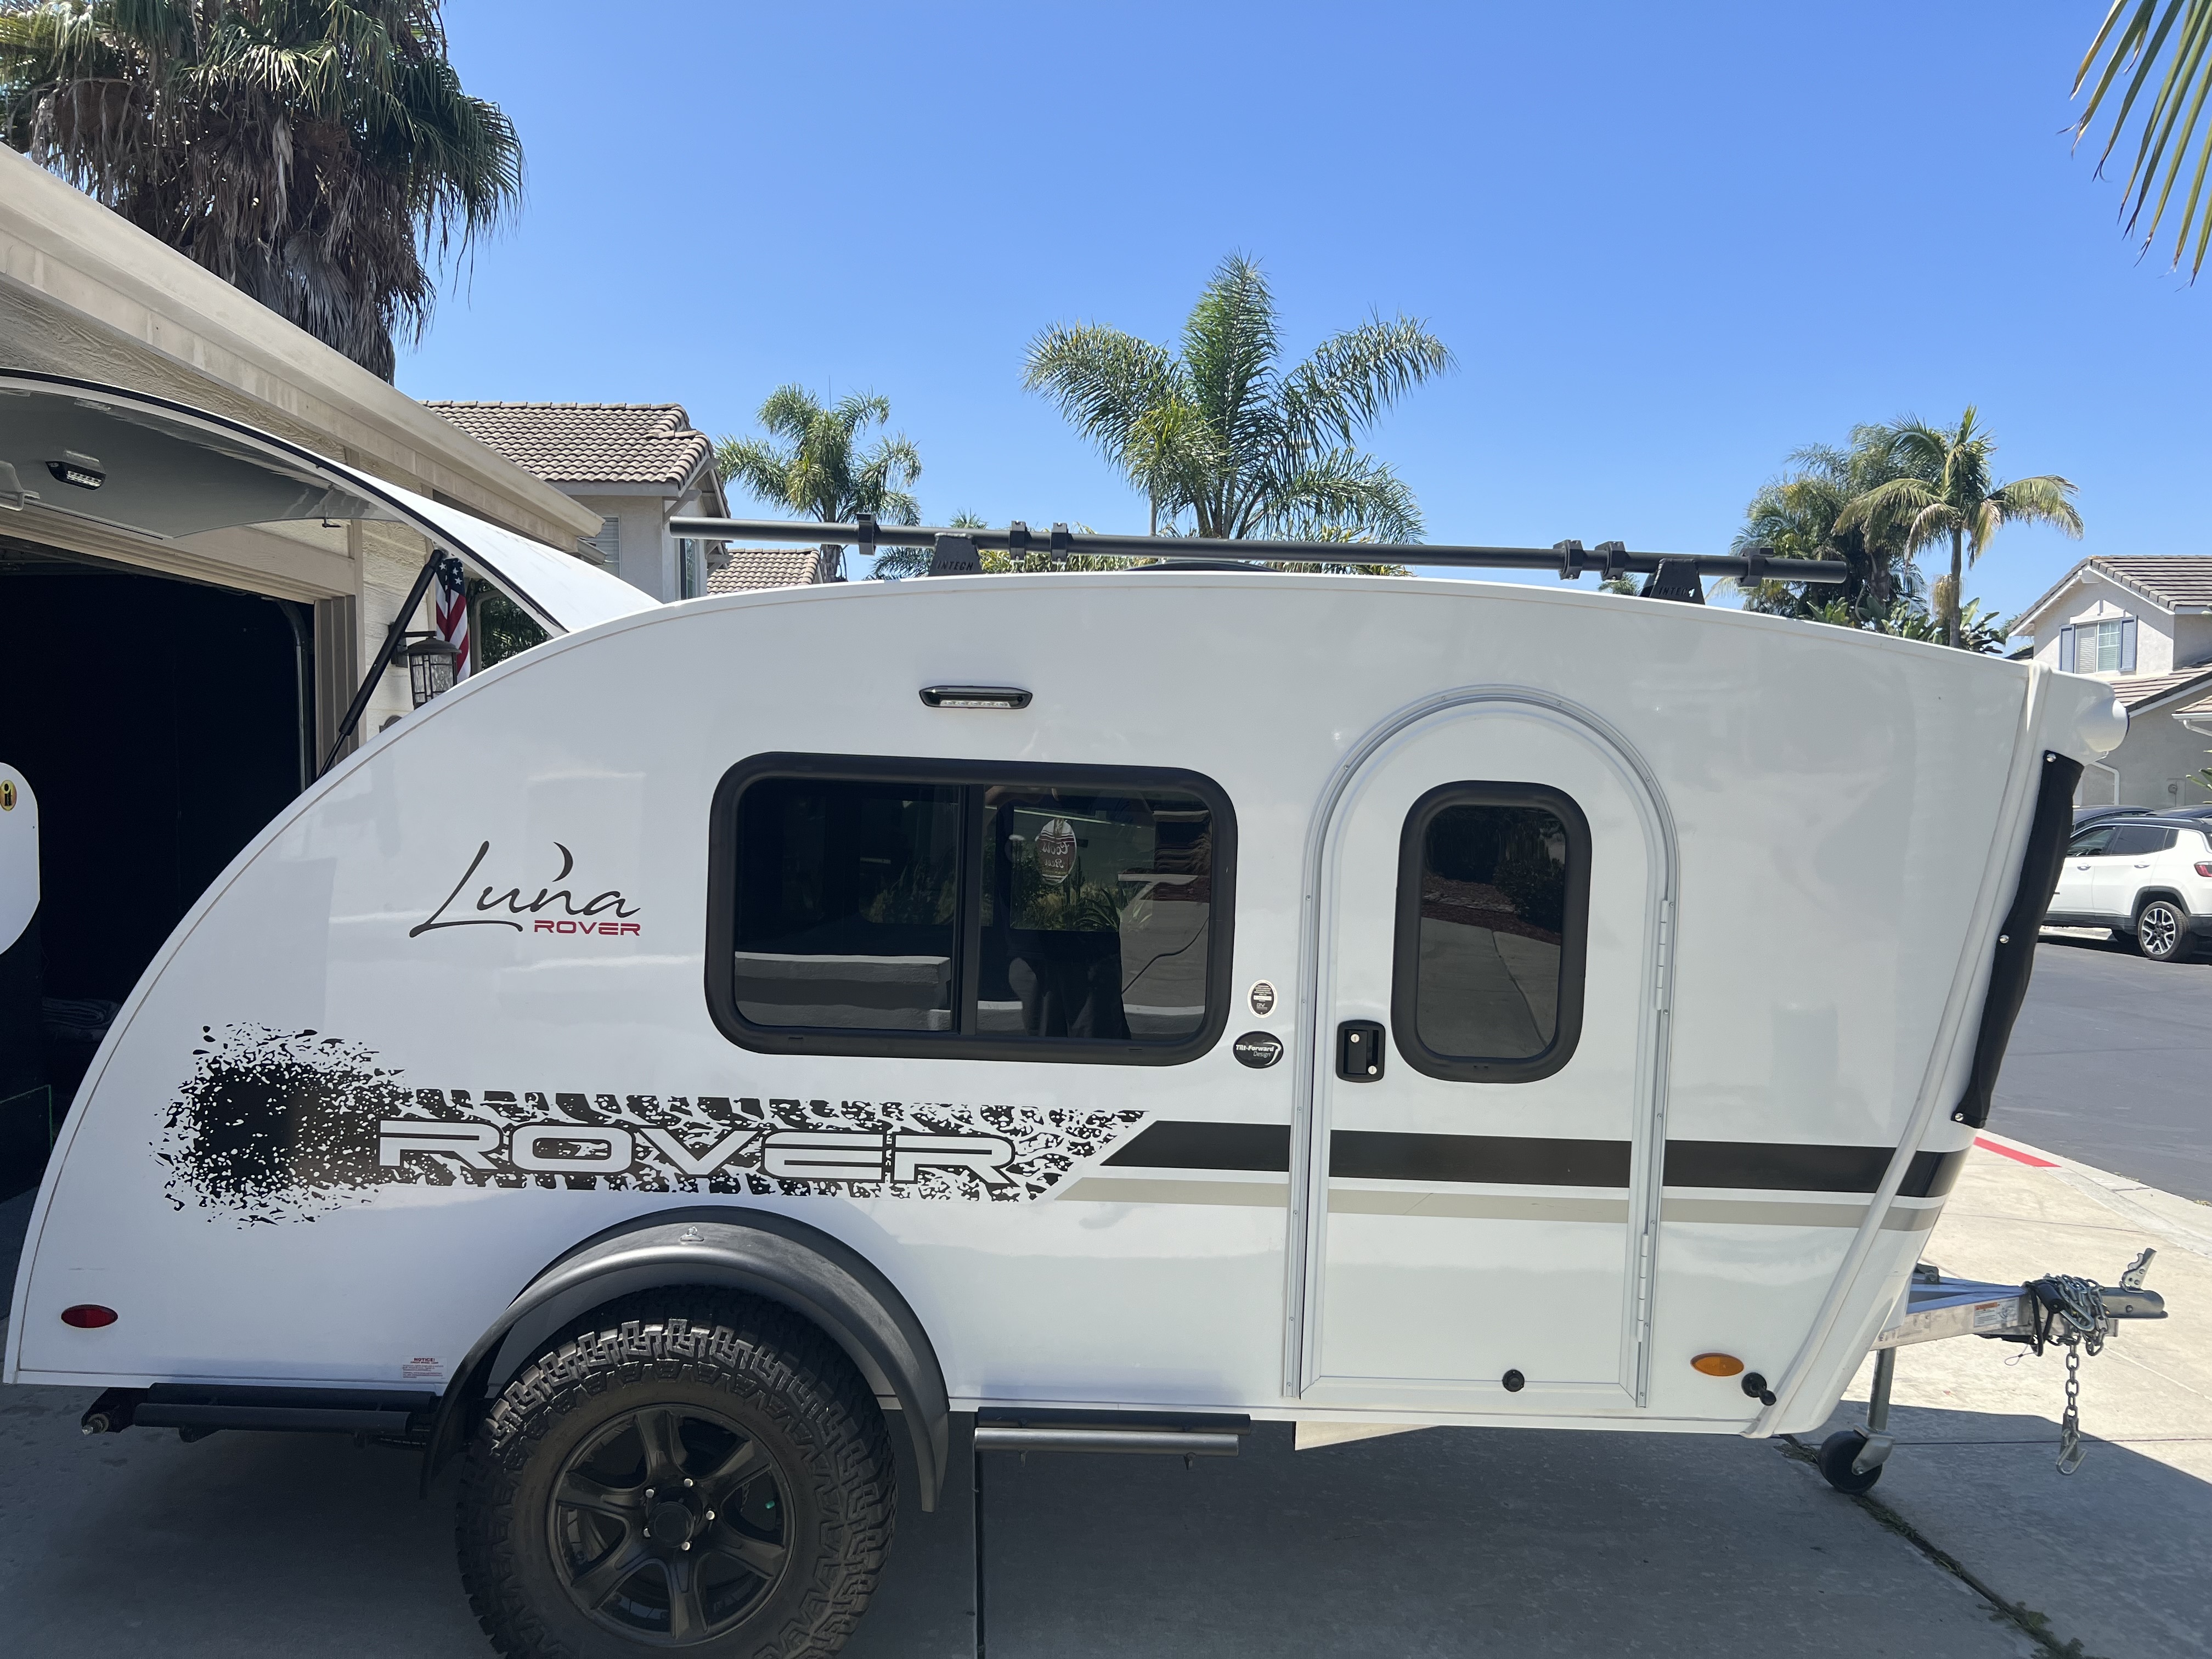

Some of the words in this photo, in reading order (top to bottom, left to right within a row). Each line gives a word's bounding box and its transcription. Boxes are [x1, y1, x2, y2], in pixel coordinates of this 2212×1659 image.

[937, 561, 974, 571] INTECH
[409, 841, 641, 938] Luna
[534, 919, 641, 936] ROVER
[378, 1119, 1018, 1184] ROVER
